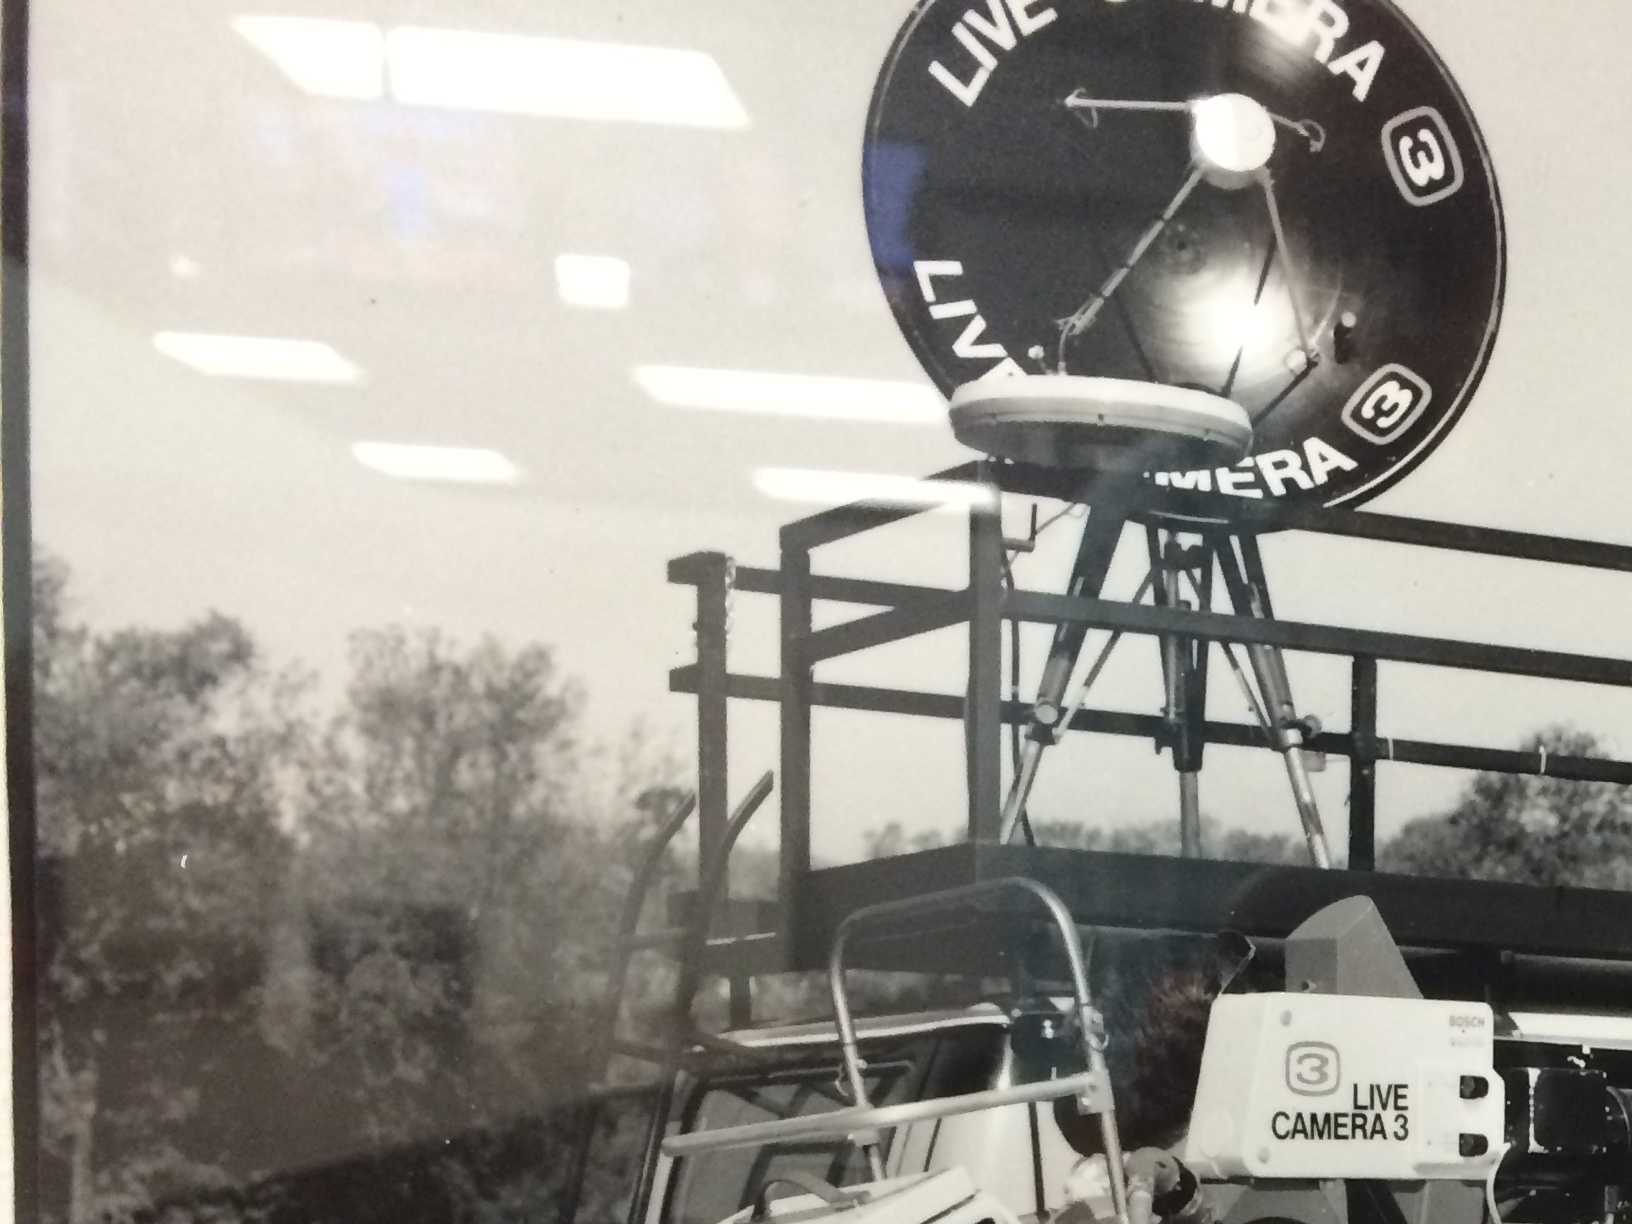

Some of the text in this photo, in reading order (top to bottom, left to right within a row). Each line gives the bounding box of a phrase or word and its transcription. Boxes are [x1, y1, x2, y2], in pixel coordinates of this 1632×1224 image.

[928, 0, 1058, 107] LIVE
[1400, 129, 1446, 188] 3
[913, 260, 1413, 499] LIV MERA 3
[1296, 1053, 1329, 1085] 3
[1353, 1083, 1409, 1111] LIVE
[1271, 1111, 1409, 1141] CAMERA 3
